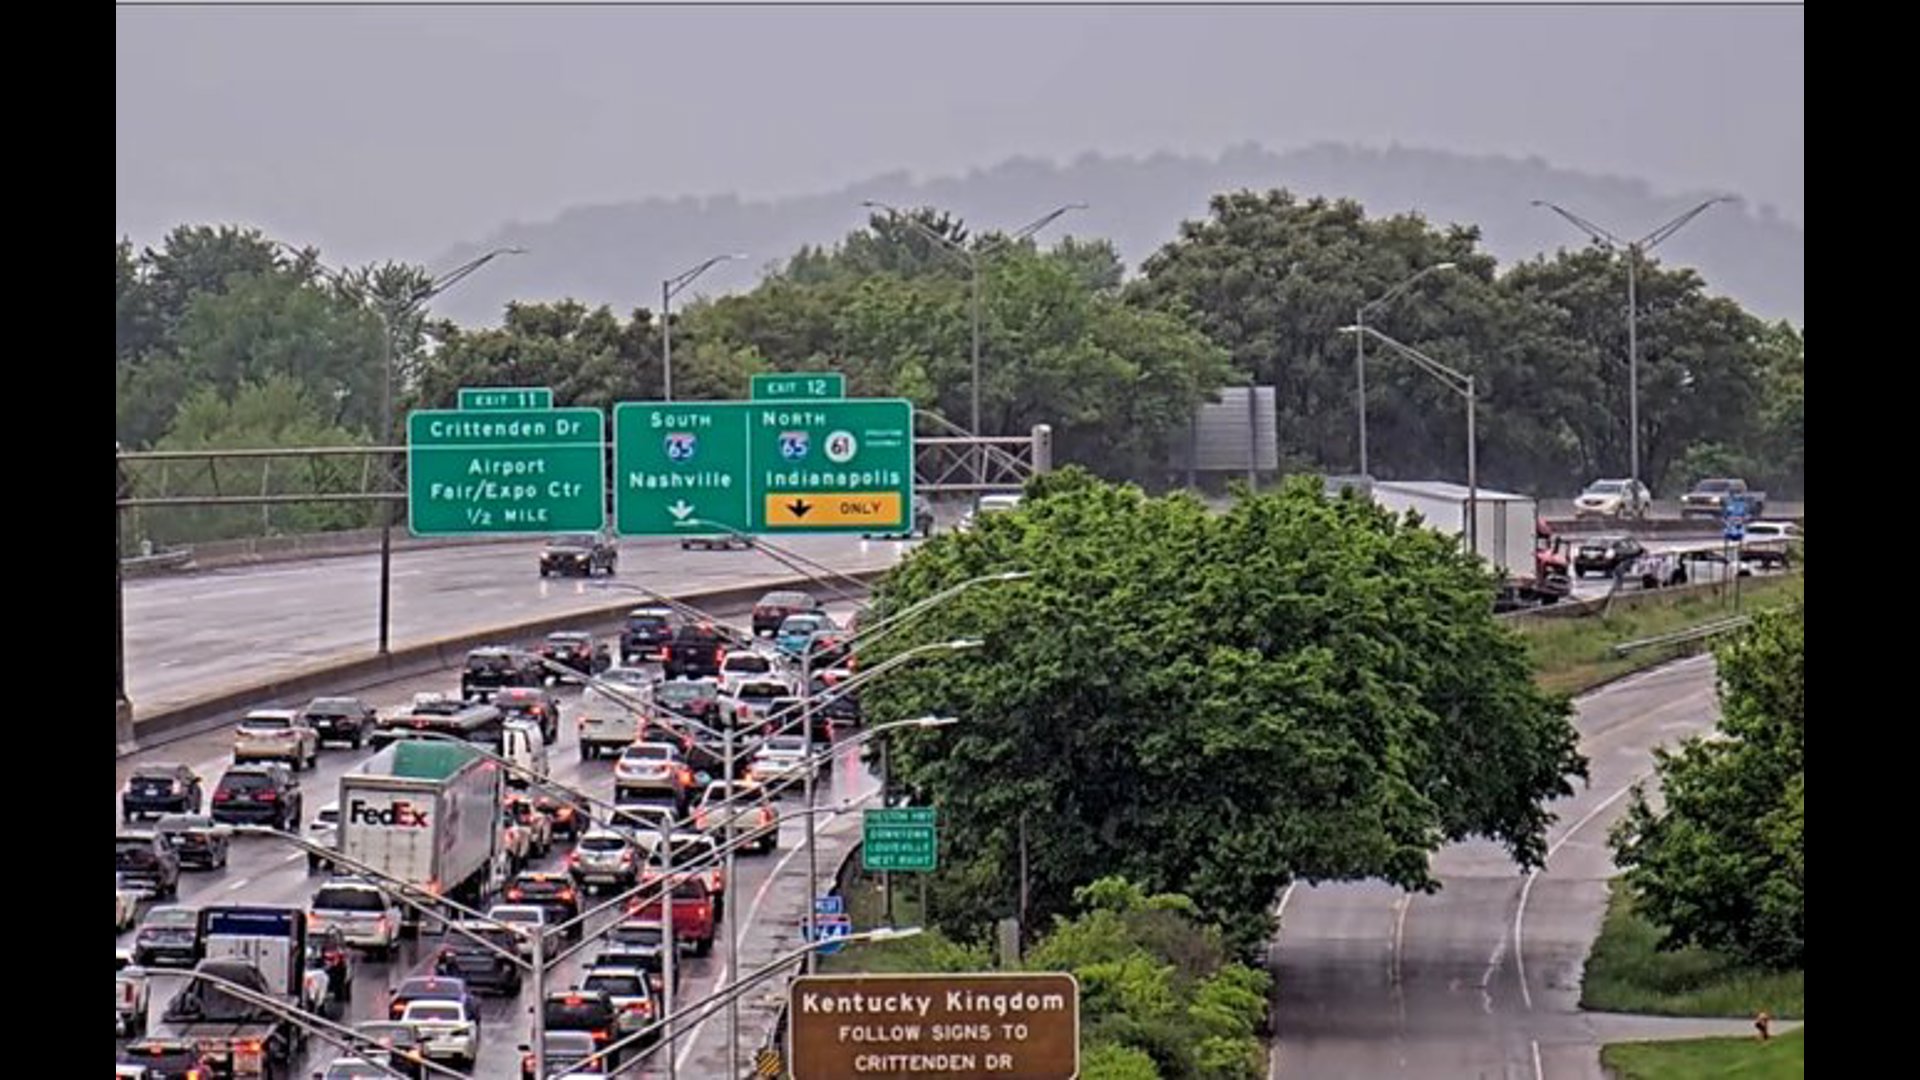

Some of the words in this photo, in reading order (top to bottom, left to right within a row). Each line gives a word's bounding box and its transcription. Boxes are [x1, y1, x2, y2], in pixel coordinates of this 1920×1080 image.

[767, 382, 796, 394] EXIT
[807, 379, 826, 395] 12
[475, 394, 507, 406] EXIT
[519, 391, 536, 407] 11
[651, 411, 711, 428] SOUTH
[763, 411, 826, 427] NORTH
[430, 420, 546, 438] Crittenden
[556, 419, 581, 436] Dr
[669, 441, 693, 458] 65
[783, 438, 808, 456] 65
[831, 437, 849, 455] 61
[468, 458, 545, 476] Airport
[629, 471, 732, 488] Nashville
[766, 469, 900, 488] Indianapolis
[430, 479, 537, 502] Fair/Expo
[547, 481, 582, 498] Ctr
[504, 508, 549, 523] MILE
[840, 502, 881, 515] ONLY
[351, 800, 429, 828] FedEx
[870, 829, 929, 839] DOWNTOWN
[803, 992, 931, 1016] Kentucky
[946, 990, 1064, 1017] Kingdom
[838, 1025, 920, 1042] FOLLOW
[932, 1024, 991, 1042] SIGNS
[1002, 1024, 1028, 1040] TO
[855, 1055, 975, 1072] CRITTENDEN
[985, 1054, 1013, 1070] DR
